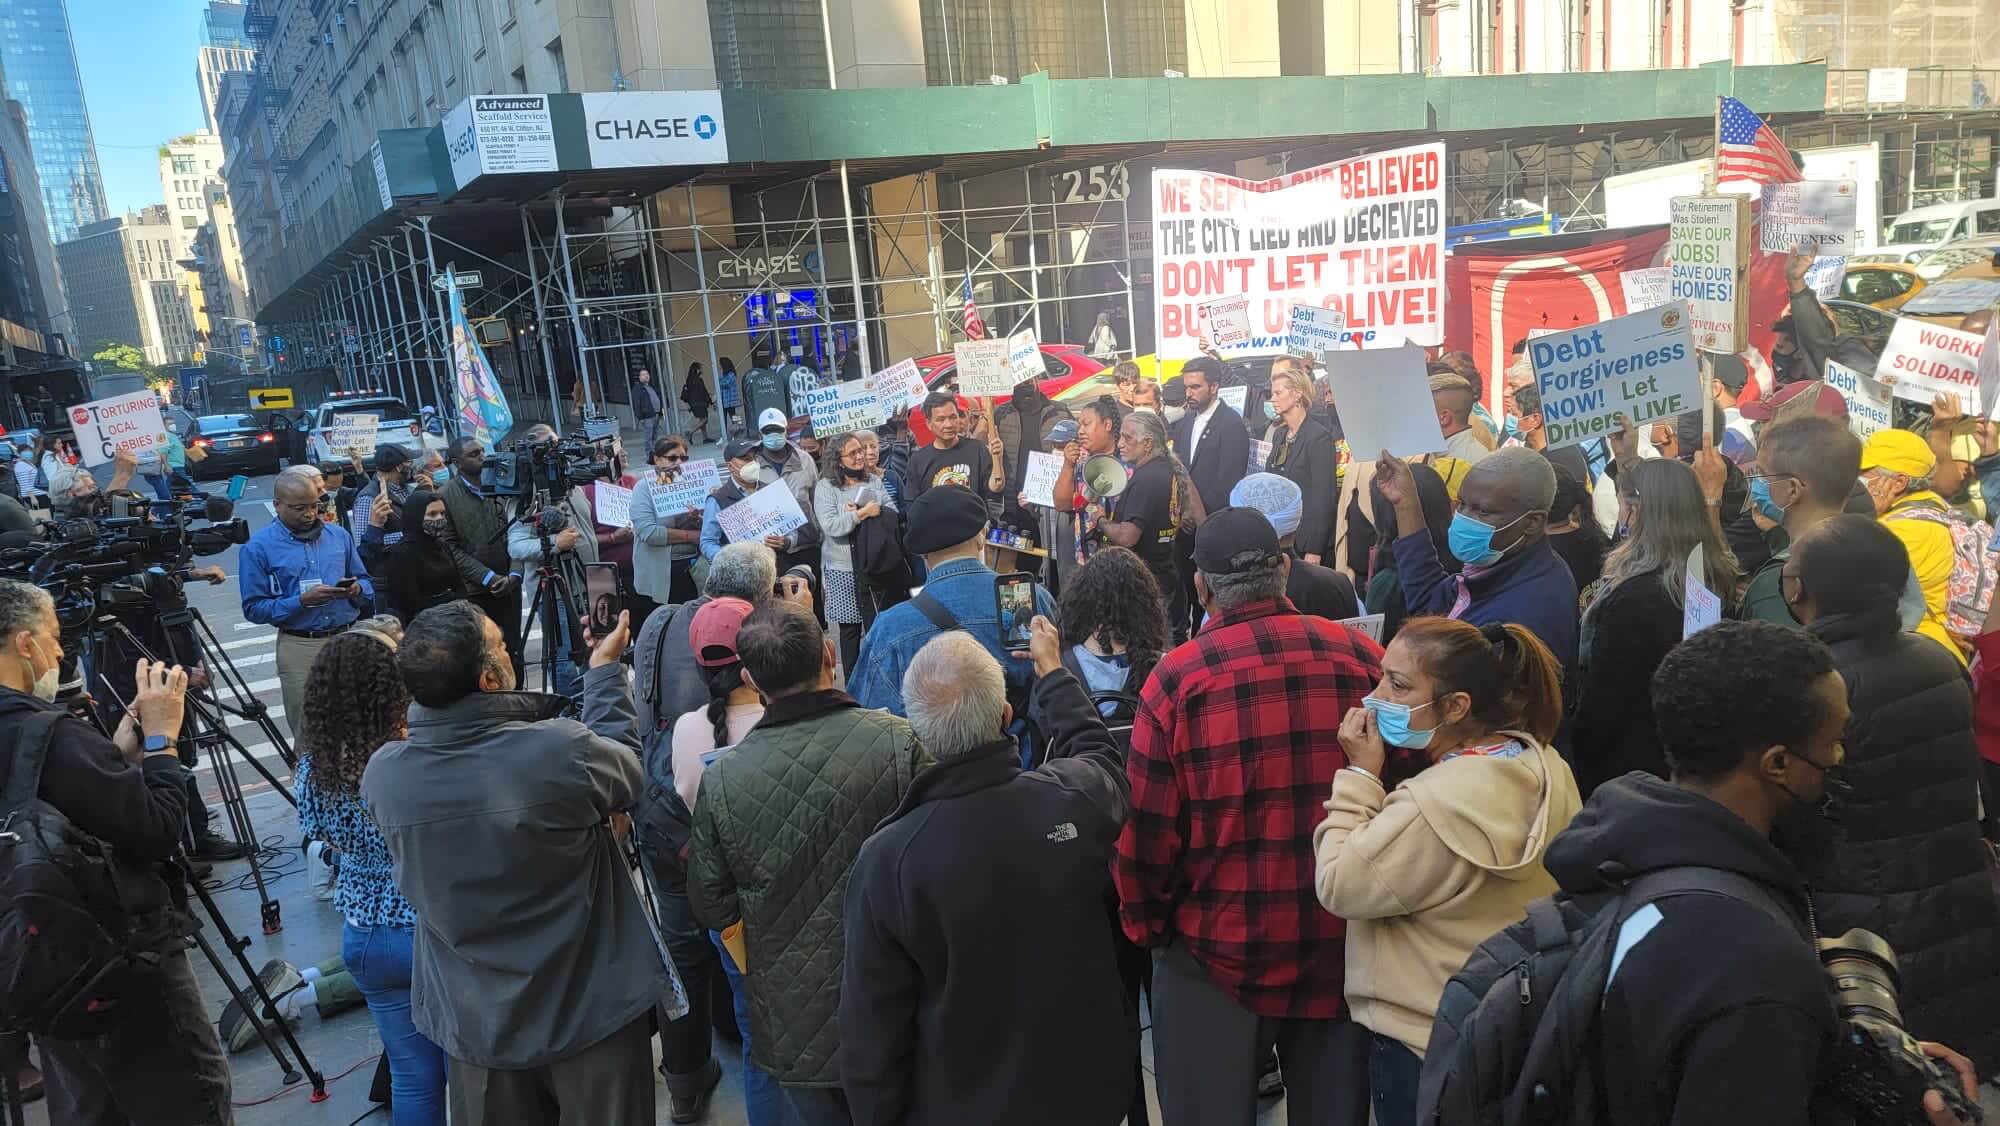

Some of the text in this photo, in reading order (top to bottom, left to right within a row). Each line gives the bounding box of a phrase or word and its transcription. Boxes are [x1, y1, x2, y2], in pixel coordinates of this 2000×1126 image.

[478, 99, 541, 110] Advanced
[478, 111, 548, 121] Scaffold Services
[595, 118, 689, 140] CHASE
[1062, 165, 1131, 203] 253
[1160, 178, 1191, 213] WE
[1340, 151, 1439, 200] BELIEVED
[1778, 183, 1800, 193] More
[1671, 201, 1732, 213] Our Retirement
[1776, 202, 1799, 213] More
[1160, 198, 1439, 255] THE CITY LIED AND DECIEVED
[1672, 213, 1719, 224] Was Stolen!
[1672, 226, 1732, 241] SAVE OUR
[1762, 223, 1788, 233] DEBT
[1761, 239, 1790, 250] NOW!
[1762, 232, 1845, 245] FORGIVENESS
[1671, 244, 1720, 264] JOBS!
[717, 254, 802, 278] CHASE
[1163, 243, 1437, 297] DON'T LET THEM
[1672, 264, 1701, 280] SAVE
[1704, 266, 1732, 282] OUR
[1672, 280, 1733, 302] HOMES!
[1292, 306, 1316, 322] Debt
[1291, 322, 1338, 341] Forgiveness
[1314, 338, 1326, 349] Let
[1533, 328, 1606, 370] Debt
[899, 368, 916, 381] LIED
[1540, 343, 1685, 396] Forgiveness
[1828, 364, 1857, 395] Debt
[806, 388, 839, 405] Debt
[1543, 374, 1659, 423] NOW! Let
[809, 395, 877, 416] Forgiveness
[334, 416, 355, 426] Debt
[812, 409, 865, 428] NOW! Let
[1546, 409, 1624, 445] Drivers
[815, 424, 851, 438] Drivers
[699, 469, 715, 477] LIED
[652, 480, 705, 497] AND DECEIVED
[654, 488, 706, 505] DON'T LET THEM
[656, 503, 675, 513] BURY
[751, 512, 785, 537] REFUSE
[787, 515, 802, 530] UP!
[1046, 829, 1069, 840] NORTH
[1055, 824, 1065, 832] THE
